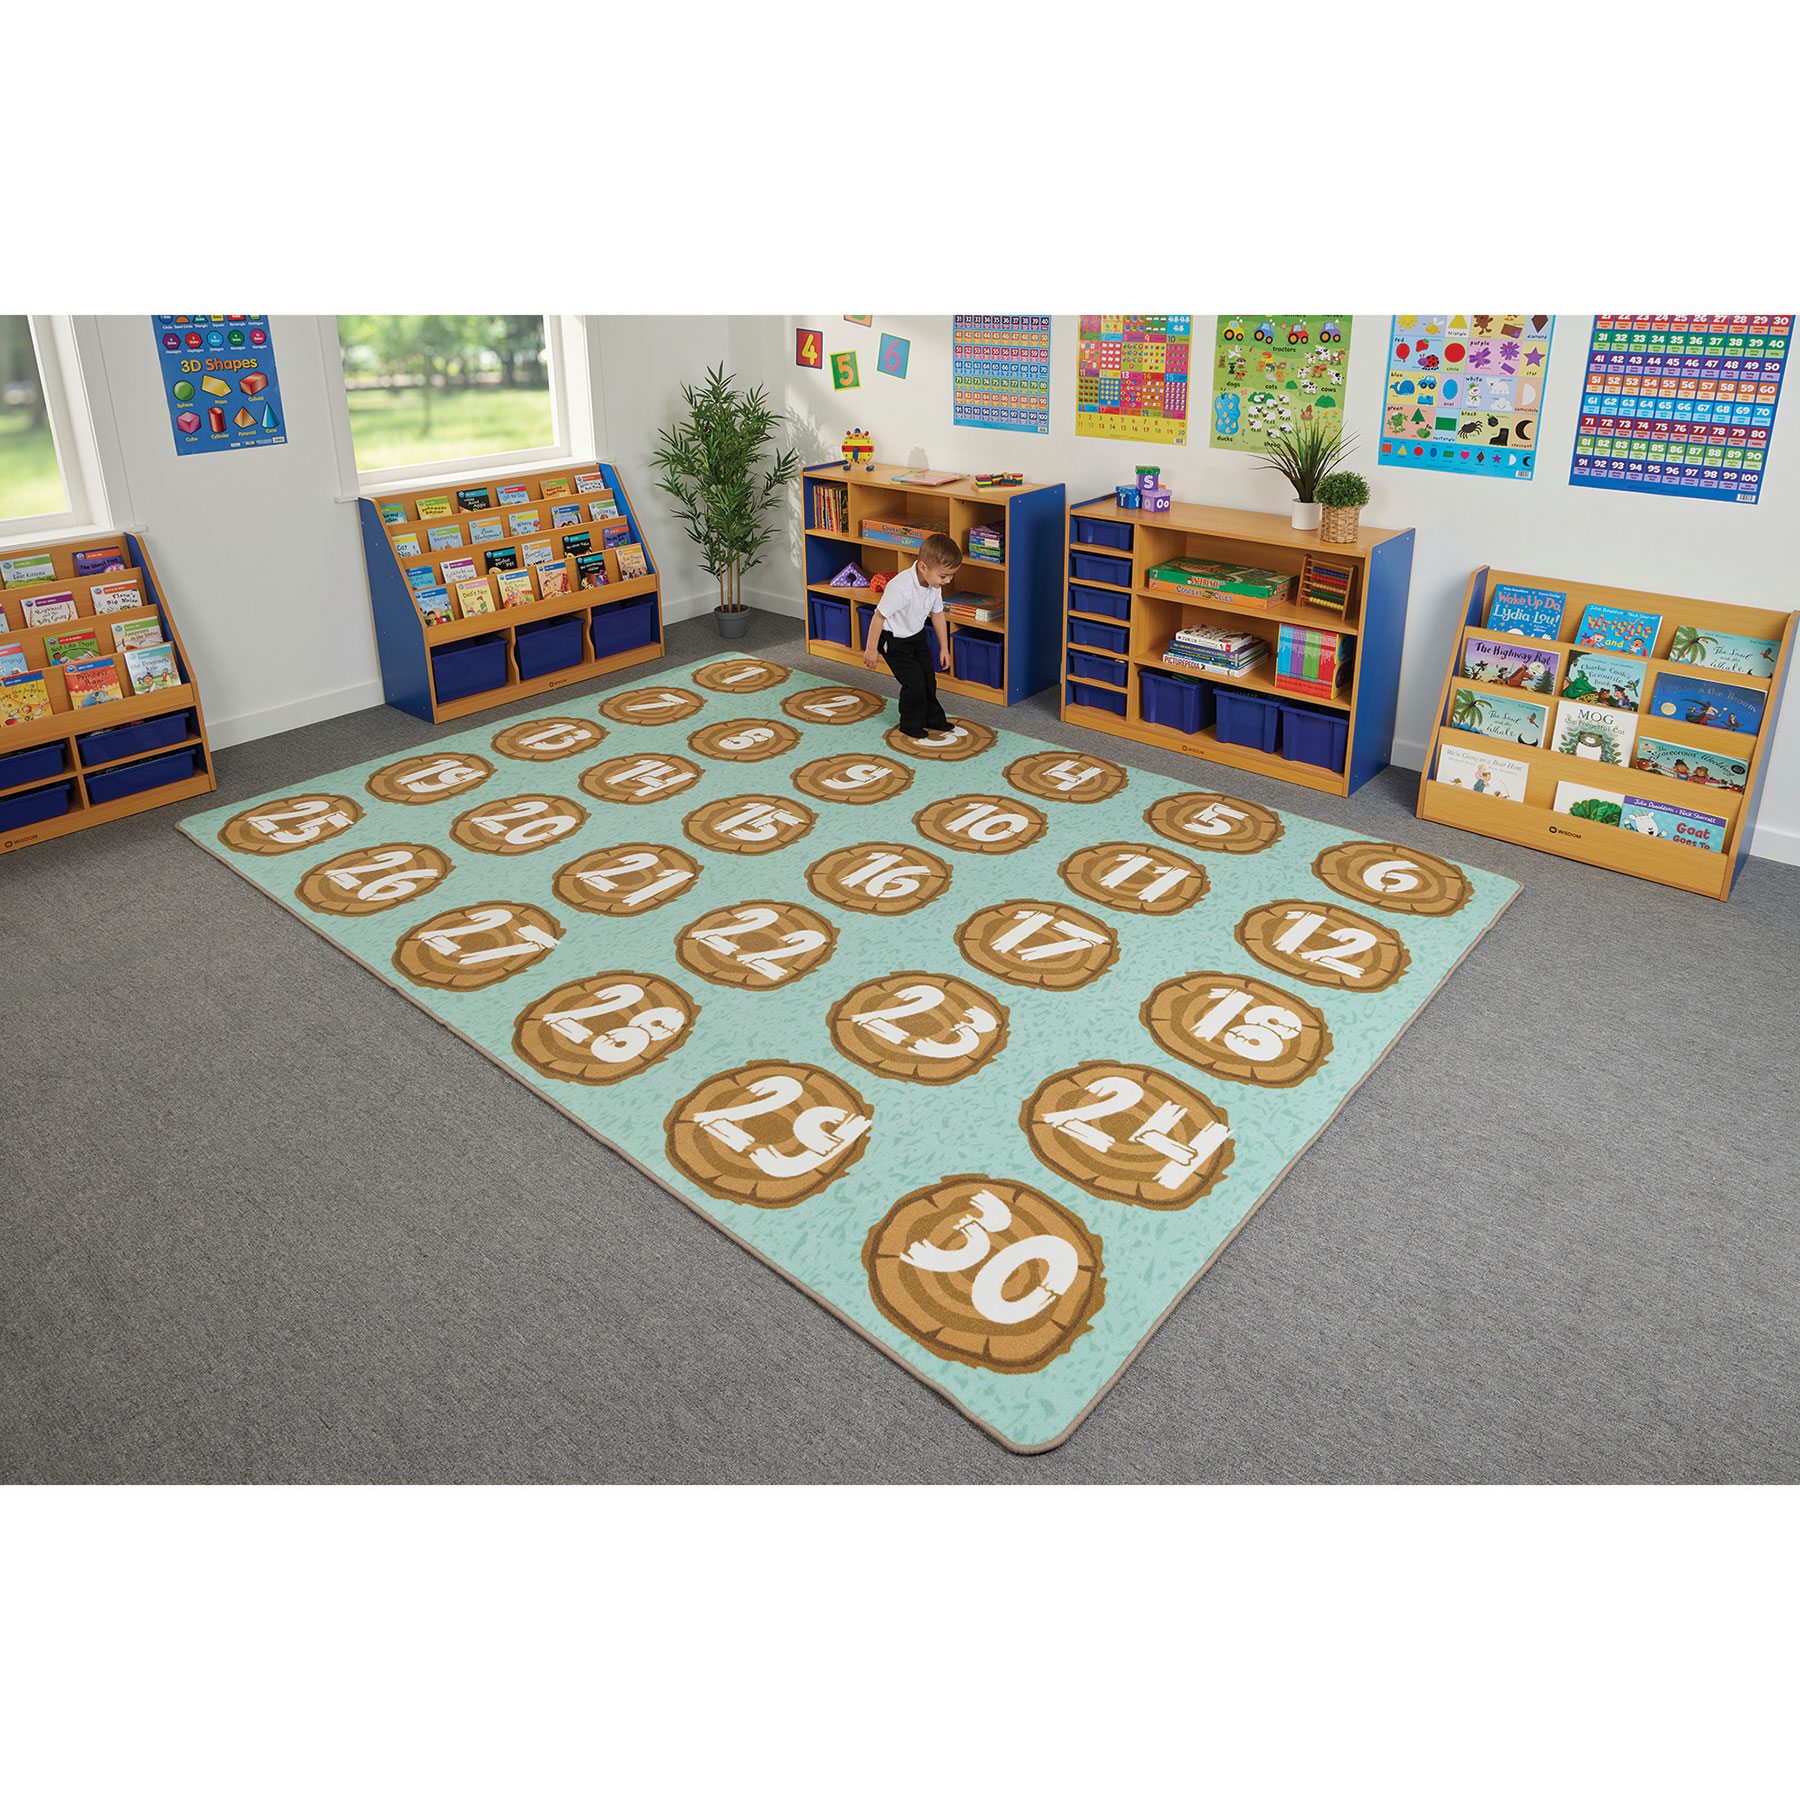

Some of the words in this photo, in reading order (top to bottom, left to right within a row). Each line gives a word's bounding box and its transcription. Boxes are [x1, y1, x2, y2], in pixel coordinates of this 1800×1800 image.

[802, 334, 818, 365] 4
[1598, 333, 1608, 341] 31
[1651, 335, 1664, 343] 34
[1671, 336, 1683, 344] 35
[1709, 337, 1723, 345] 37
[1729, 338, 1743, 346] 38
[1749, 339, 1763, 347] 39
[1769, 340, 1784, 348] 40
[181, 360, 202, 373] 3D
[205, 357, 258, 372] Shapes
[884, 340, 901, 372] 6
[837, 354, 854, 386] 5
[1144, 475, 1154, 489] S
[1630, 463, 1642, 471] 94
[1648, 465, 1660, 473] 95
[1666, 467, 1679, 475] 96
[1704, 470, 1717, 478] 98
[1723, 472, 1737, 480] 99
[1741, 474, 1758, 482] 100
[1176, 585, 1202, 597] CONTEXT
[1213, 592, 1233, 602] CLUES
[1498, 591, 1527, 605] Wake
[1527, 595, 1543, 608] Up
[1493, 604, 1530, 622] Lydia
[1533, 612, 1560, 627] Lou!
[1588, 614, 1653, 641] Wriggle
[1475, 642, 1491, 653] The
[1493, 643, 1533, 663] Highway
[1533, 653, 1552, 665] Rat
[1605, 638, 1624, 648] and
[1713, 646, 1728, 655] The
[1729, 648, 1753, 659] Snail
[1164, 654, 1200, 670] PICTUREPEDIA
[1580, 663, 1607, 672] Charlie
[1609, 668, 1631, 680] Cook's
[76, 670, 108, 681] Princess
[722, 667, 767, 684] 1
[1587, 672, 1623, 684] Favourite
[1594, 678, 1611, 687] Book
[628, 694, 688, 710] 7
[805, 696, 859, 716] 2
[1727, 692, 1757, 713] Broom
[1488, 710, 1501, 719] The
[1503, 712, 1522, 724] Snail
[1577, 709, 1614, 725] MOG
[1578, 719, 1610, 732] Forgetful
[1612, 727, 1625, 735] Cat
[520, 724, 591, 749] 13
[720, 729, 774, 749] 8
[913, 726, 969, 747] 3
[1487, 726, 1515, 737] Whale
[398, 760, 486, 792] 19
[606, 760, 693, 796] 14
[823, 765, 891, 789] 9
[1043, 760, 1104, 790] 4
[1507, 762, 1522, 771] Hunt
[249, 801, 353, 843] 25
[472, 802, 576, 844] 20
[715, 804, 804, 840] 15
[946, 804, 1028, 841] 10
[1184, 803, 1248, 835] 5
[1634, 798, 1647, 807] Julia
[1649, 801, 1674, 813] Donaldson
[1679, 809, 1692, 817] Nick
[1692, 812, 1716, 824] Sharratt
[1558, 829, 1581, 839] WISDOM
[1673, 835, 1697, 848] Goes
[1699, 841, 1711, 850] To
[1676, 823, 1711, 839] Goat
[326, 851, 437, 900] 26
[576, 854, 694, 906] 21
[842, 853, 930, 897] 16
[1102, 855, 1190, 902] 11
[1364, 861, 1418, 892] 6
[418, 910, 561, 964] 27
[692, 909, 825, 980] 22
[992, 912, 1108, 960] 17
[1274, 912, 1376, 978] 12
[543, 985, 684, 1062] 28
[852, 986, 996, 1058] 23
[1192, 989, 1301, 1061] 18
[694, 1076, 872, 1177] 29
[1044, 1077, 1232, 1189] 24
[900, 1190, 1078, 1324] 30
